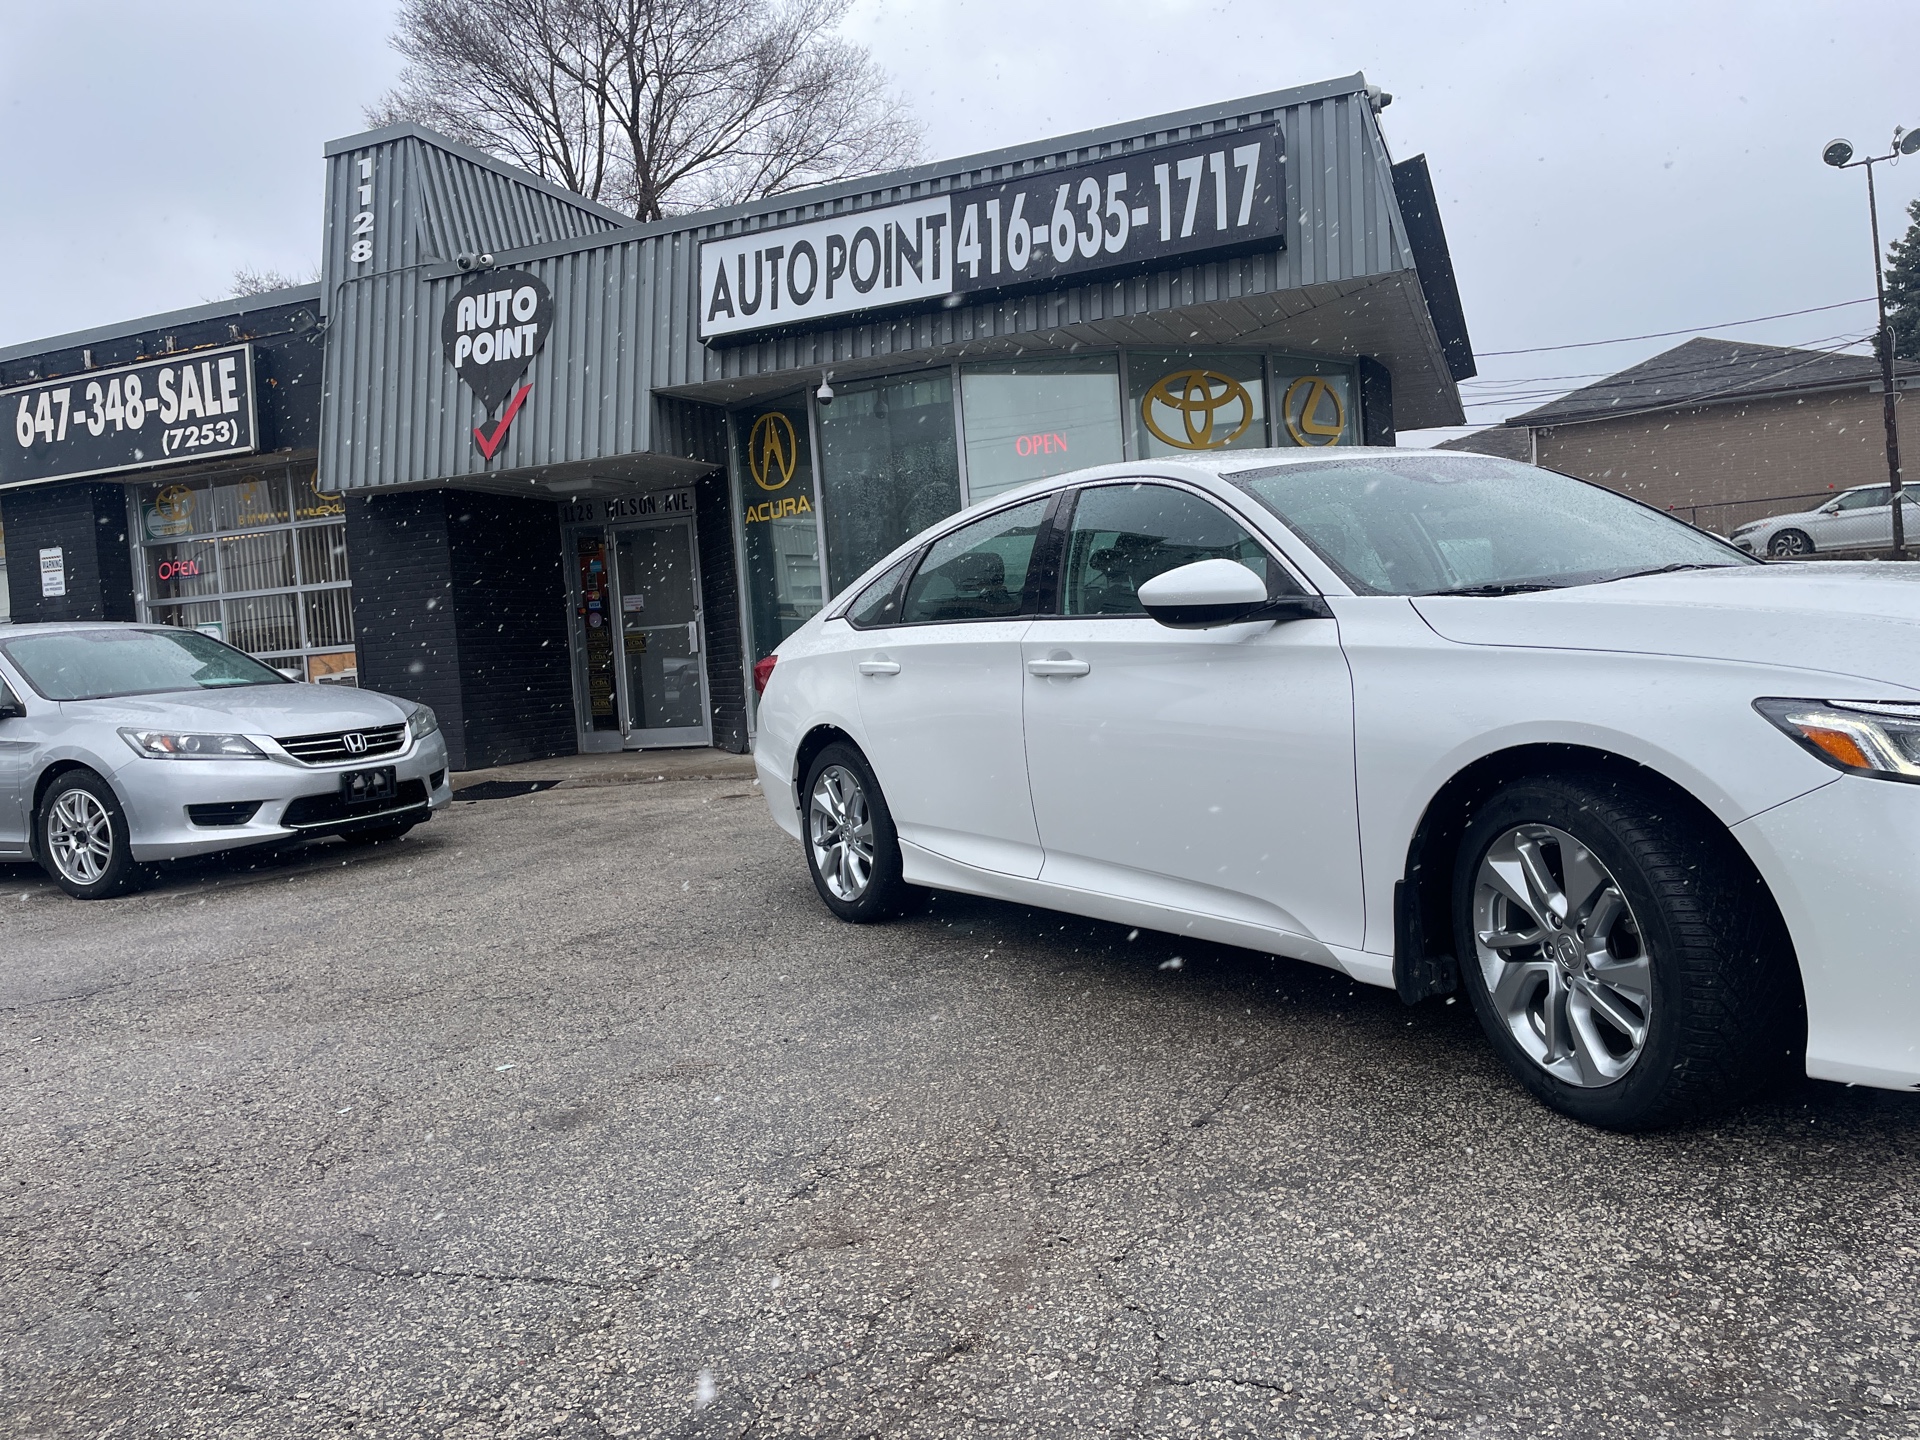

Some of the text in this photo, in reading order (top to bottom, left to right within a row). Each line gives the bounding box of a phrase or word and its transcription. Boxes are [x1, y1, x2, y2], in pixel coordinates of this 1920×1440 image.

[350, 158, 375, 263] 1128
[707, 142, 1261, 322] AUTO POINT 416-635-1717
[456, 285, 538, 333] AUTO
[454, 323, 538, 369] POINT
[16, 357, 239, 448] 647-348-SALE
[162, 419, 239, 456] (7253)
[1015, 432, 1068, 456] OPEN
[562, 493, 693, 523] 1128 WILSON AVE.
[745, 495, 812, 524] ACURA
[158, 560, 199, 580] OPEN
